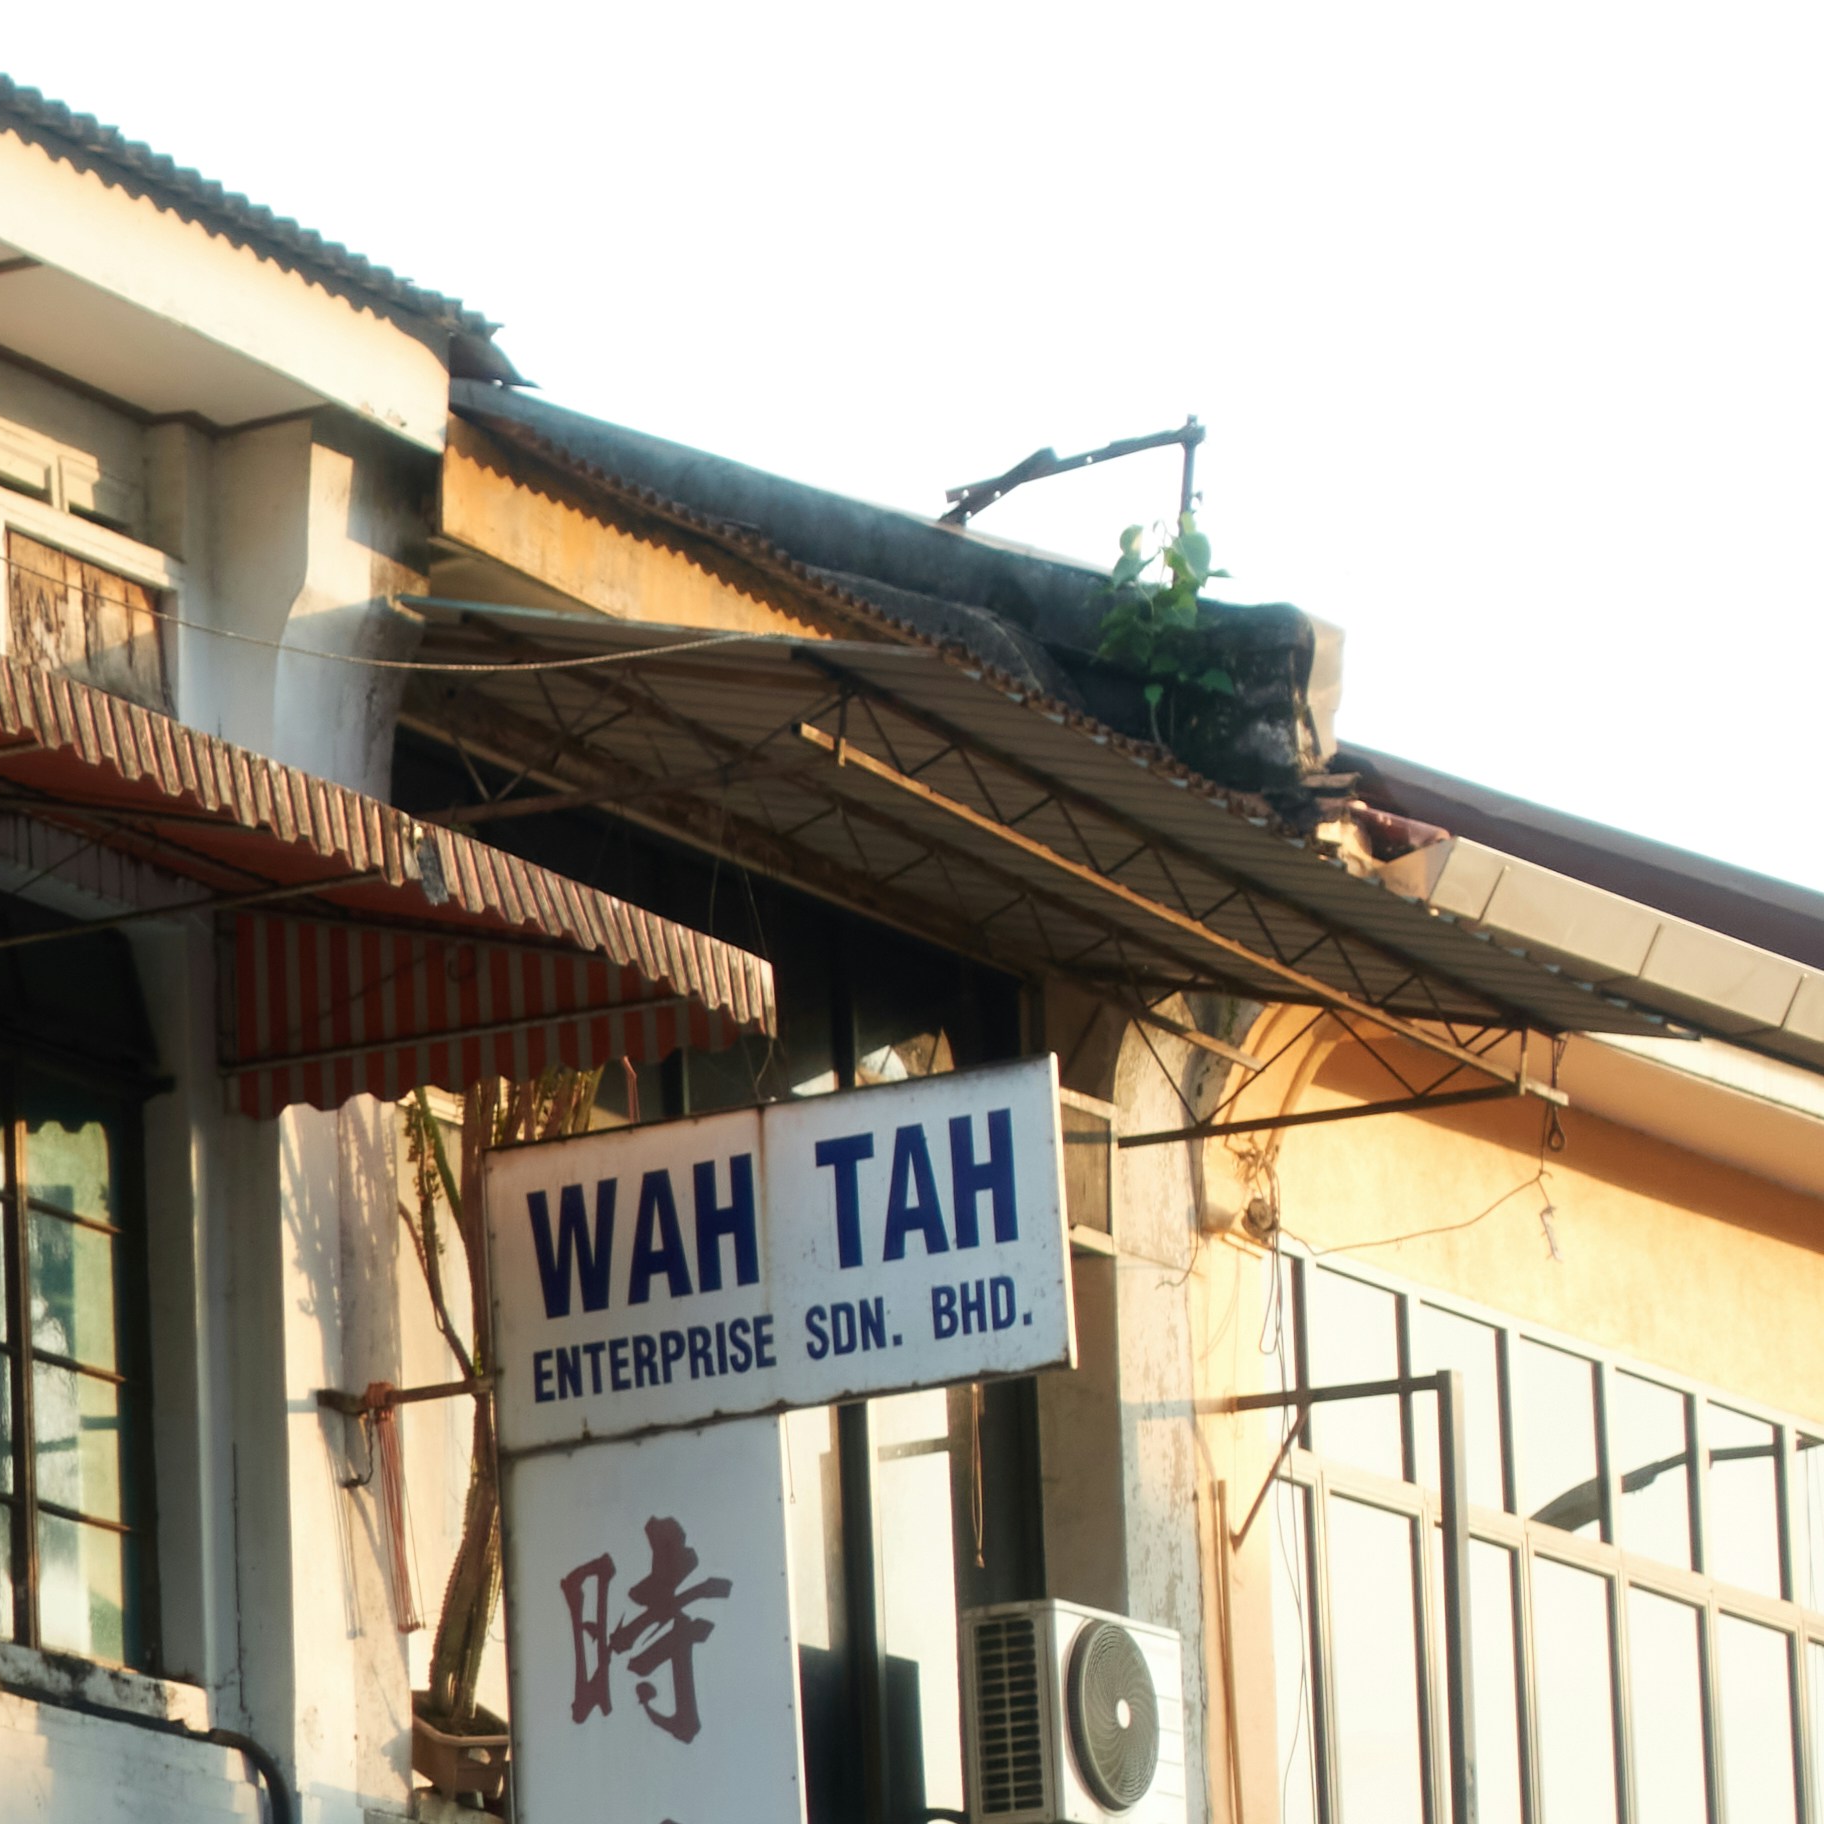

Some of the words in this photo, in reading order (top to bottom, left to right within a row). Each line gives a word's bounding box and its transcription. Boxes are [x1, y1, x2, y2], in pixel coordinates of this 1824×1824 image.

[526, 1152, 761, 1321] WAH
[814, 1107, 1019, 1270] TAH
[532, 1313, 777, 1404] ENTERPRISE
[804, 1296, 903, 1362] SDN.
[930, 1274, 1033, 1341] BHD.
